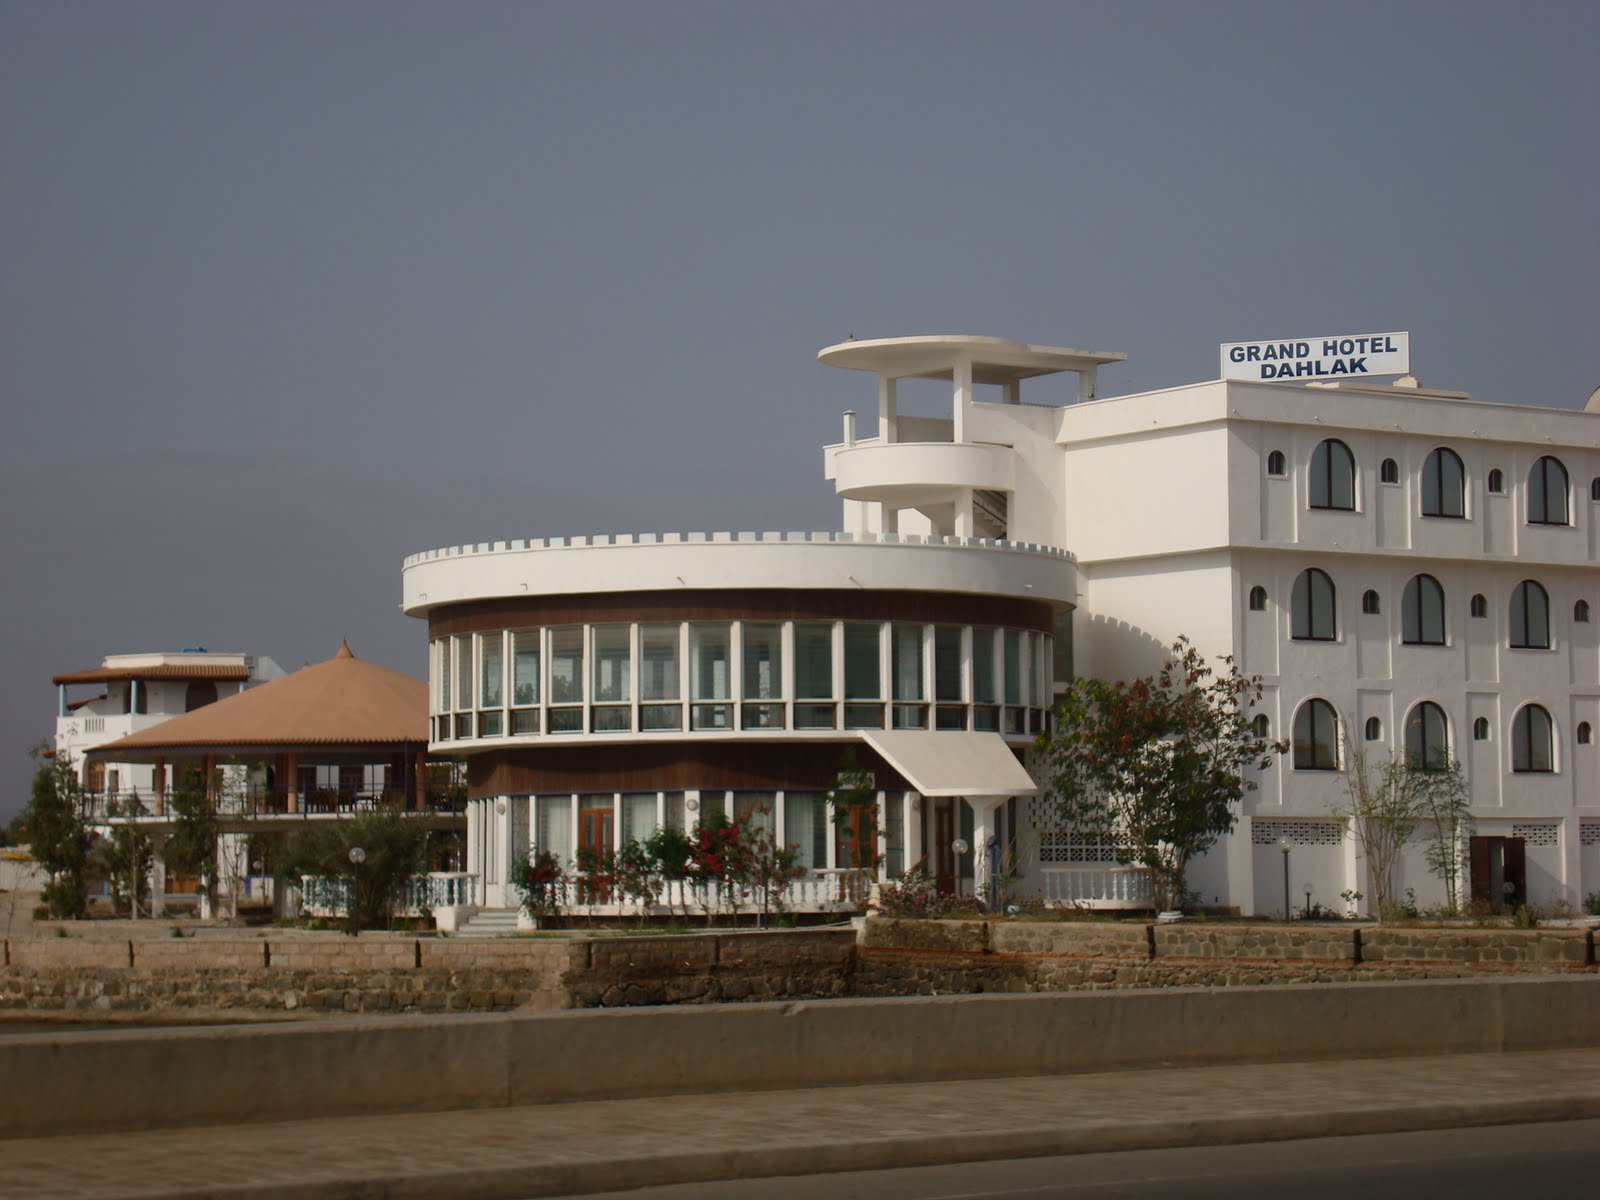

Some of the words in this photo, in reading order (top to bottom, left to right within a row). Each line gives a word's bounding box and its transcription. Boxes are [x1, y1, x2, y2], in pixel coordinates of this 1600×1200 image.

[1230, 342, 1310, 363] GRAND
[1323, 337, 1397, 356] HOTEL
[1261, 357, 1368, 379] DAHLAK
